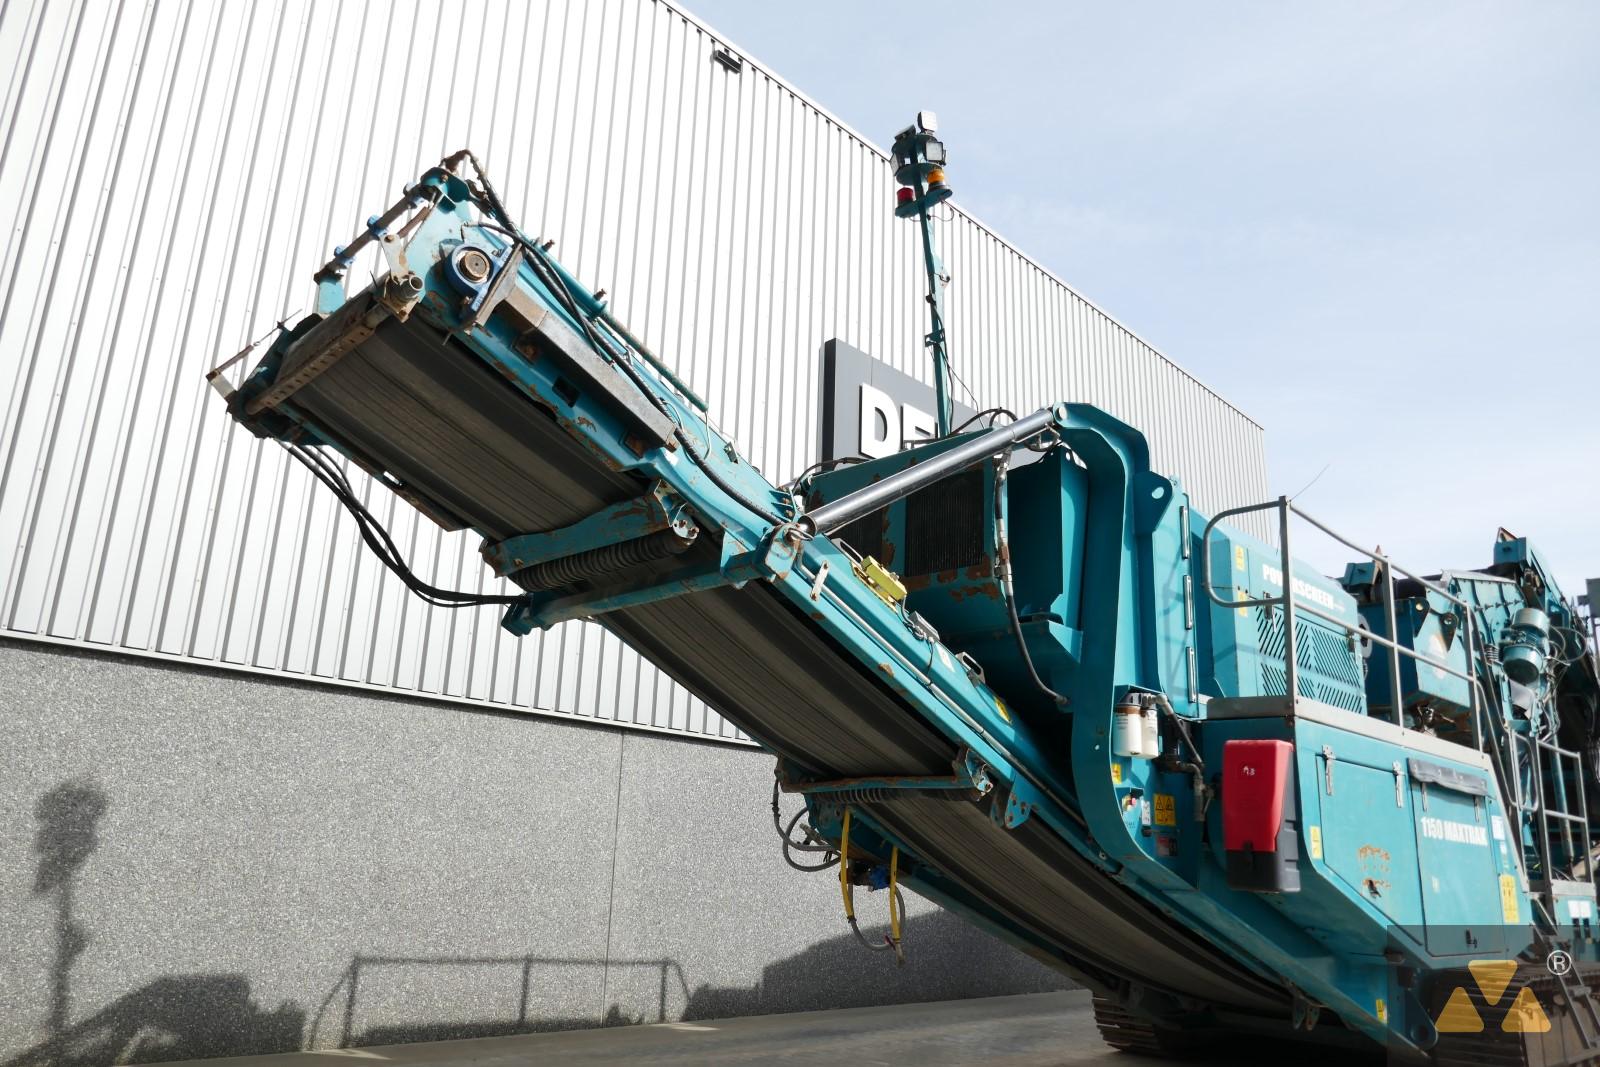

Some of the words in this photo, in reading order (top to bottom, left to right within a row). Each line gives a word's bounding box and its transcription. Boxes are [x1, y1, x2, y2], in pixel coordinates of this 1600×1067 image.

[1262, 563, 1334, 609] POWRSCREEN
[1420, 817, 1443, 840] 1150
[1444, 820, 1488, 846] MAXTRAK
